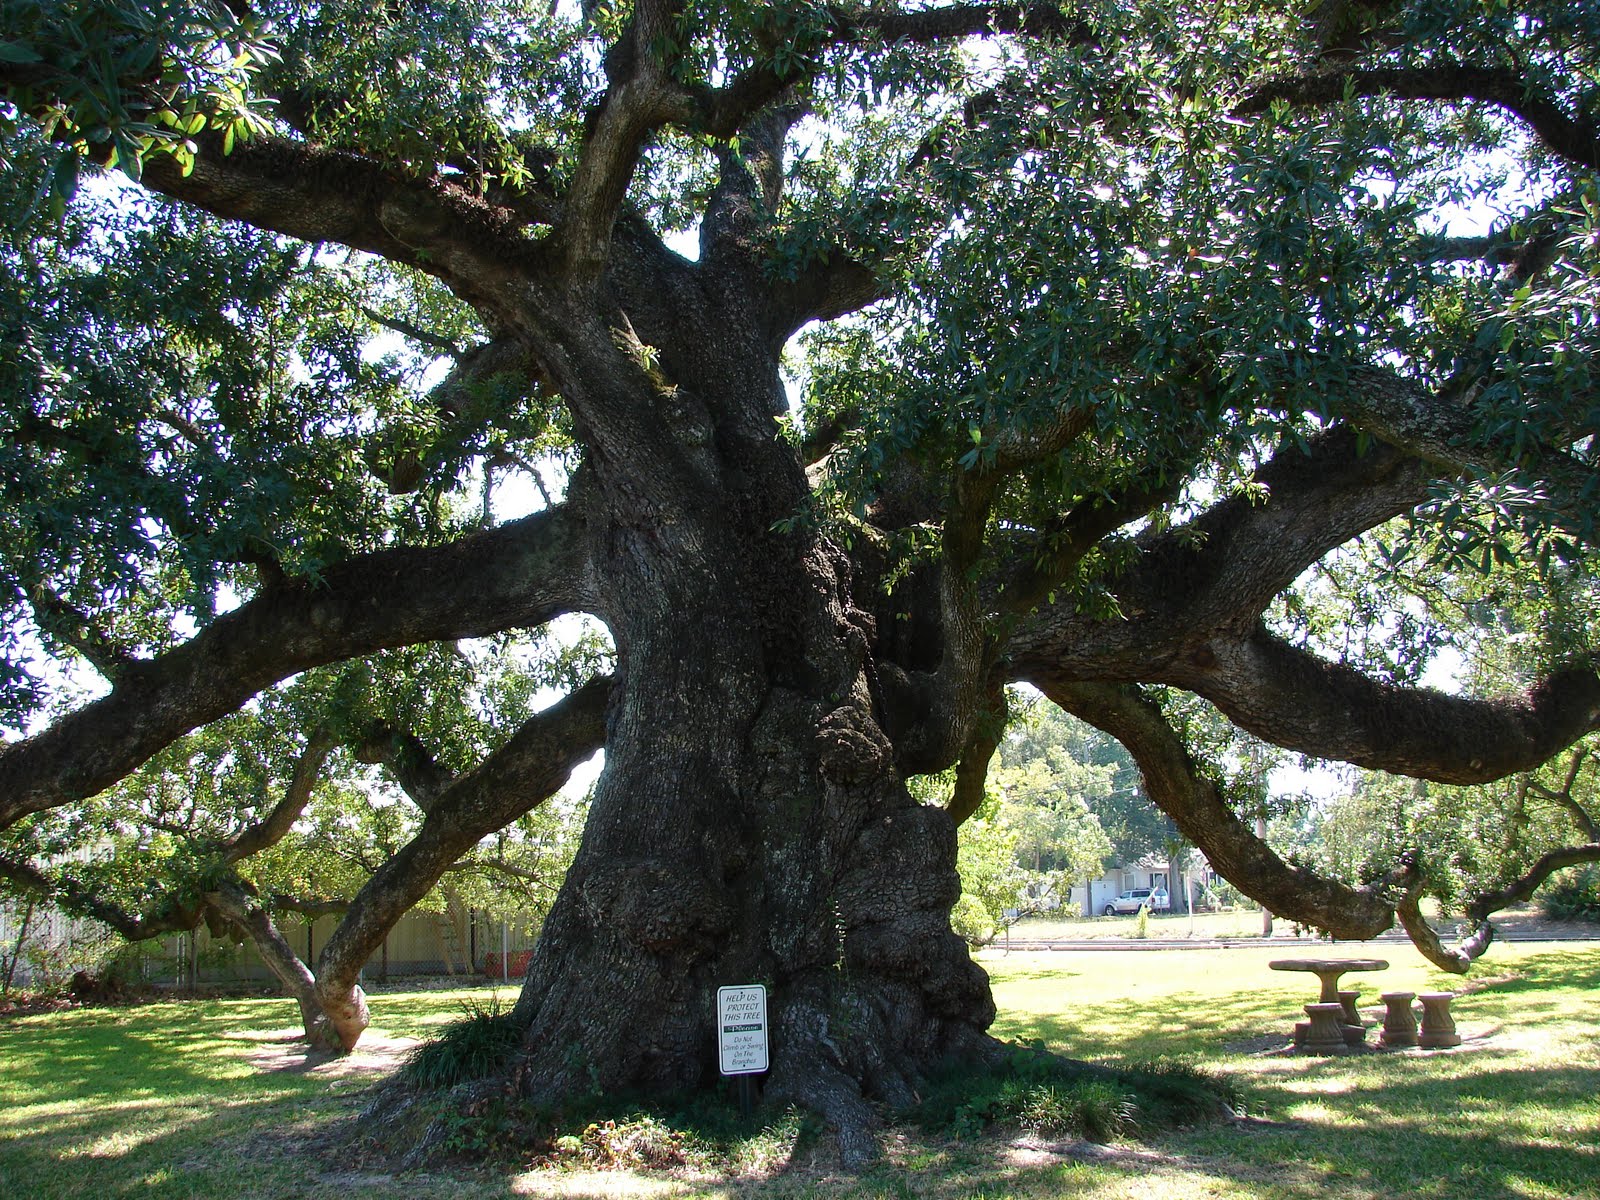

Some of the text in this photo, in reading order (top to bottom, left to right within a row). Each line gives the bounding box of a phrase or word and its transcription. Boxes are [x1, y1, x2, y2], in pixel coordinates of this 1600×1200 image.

[726, 994, 745, 1002] HELP
[727, 1003, 759, 1011] PROTECT
[725, 1012, 760, 1021] THIS TREE
[747, 1043, 763, 1051] Swing
